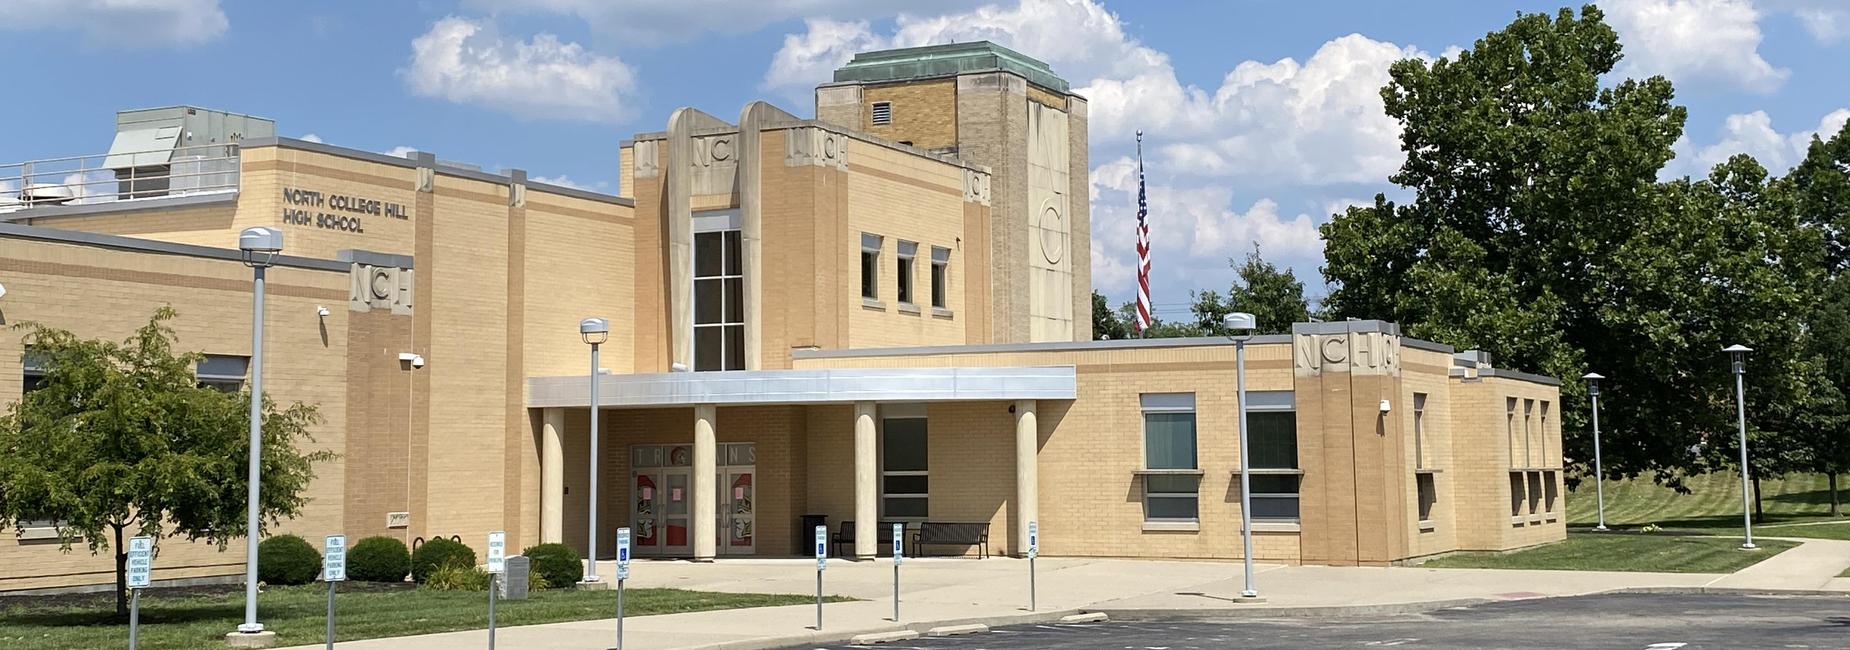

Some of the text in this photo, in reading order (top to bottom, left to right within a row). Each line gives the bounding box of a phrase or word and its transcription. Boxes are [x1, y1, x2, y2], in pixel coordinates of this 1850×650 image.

[283, 187, 409, 220] NORTH COLLEGE HILL
[283, 208, 364, 234] HIGH SCHOOL
[351, 262, 413, 309] NCH
[1294, 332, 1379, 370] NCH
